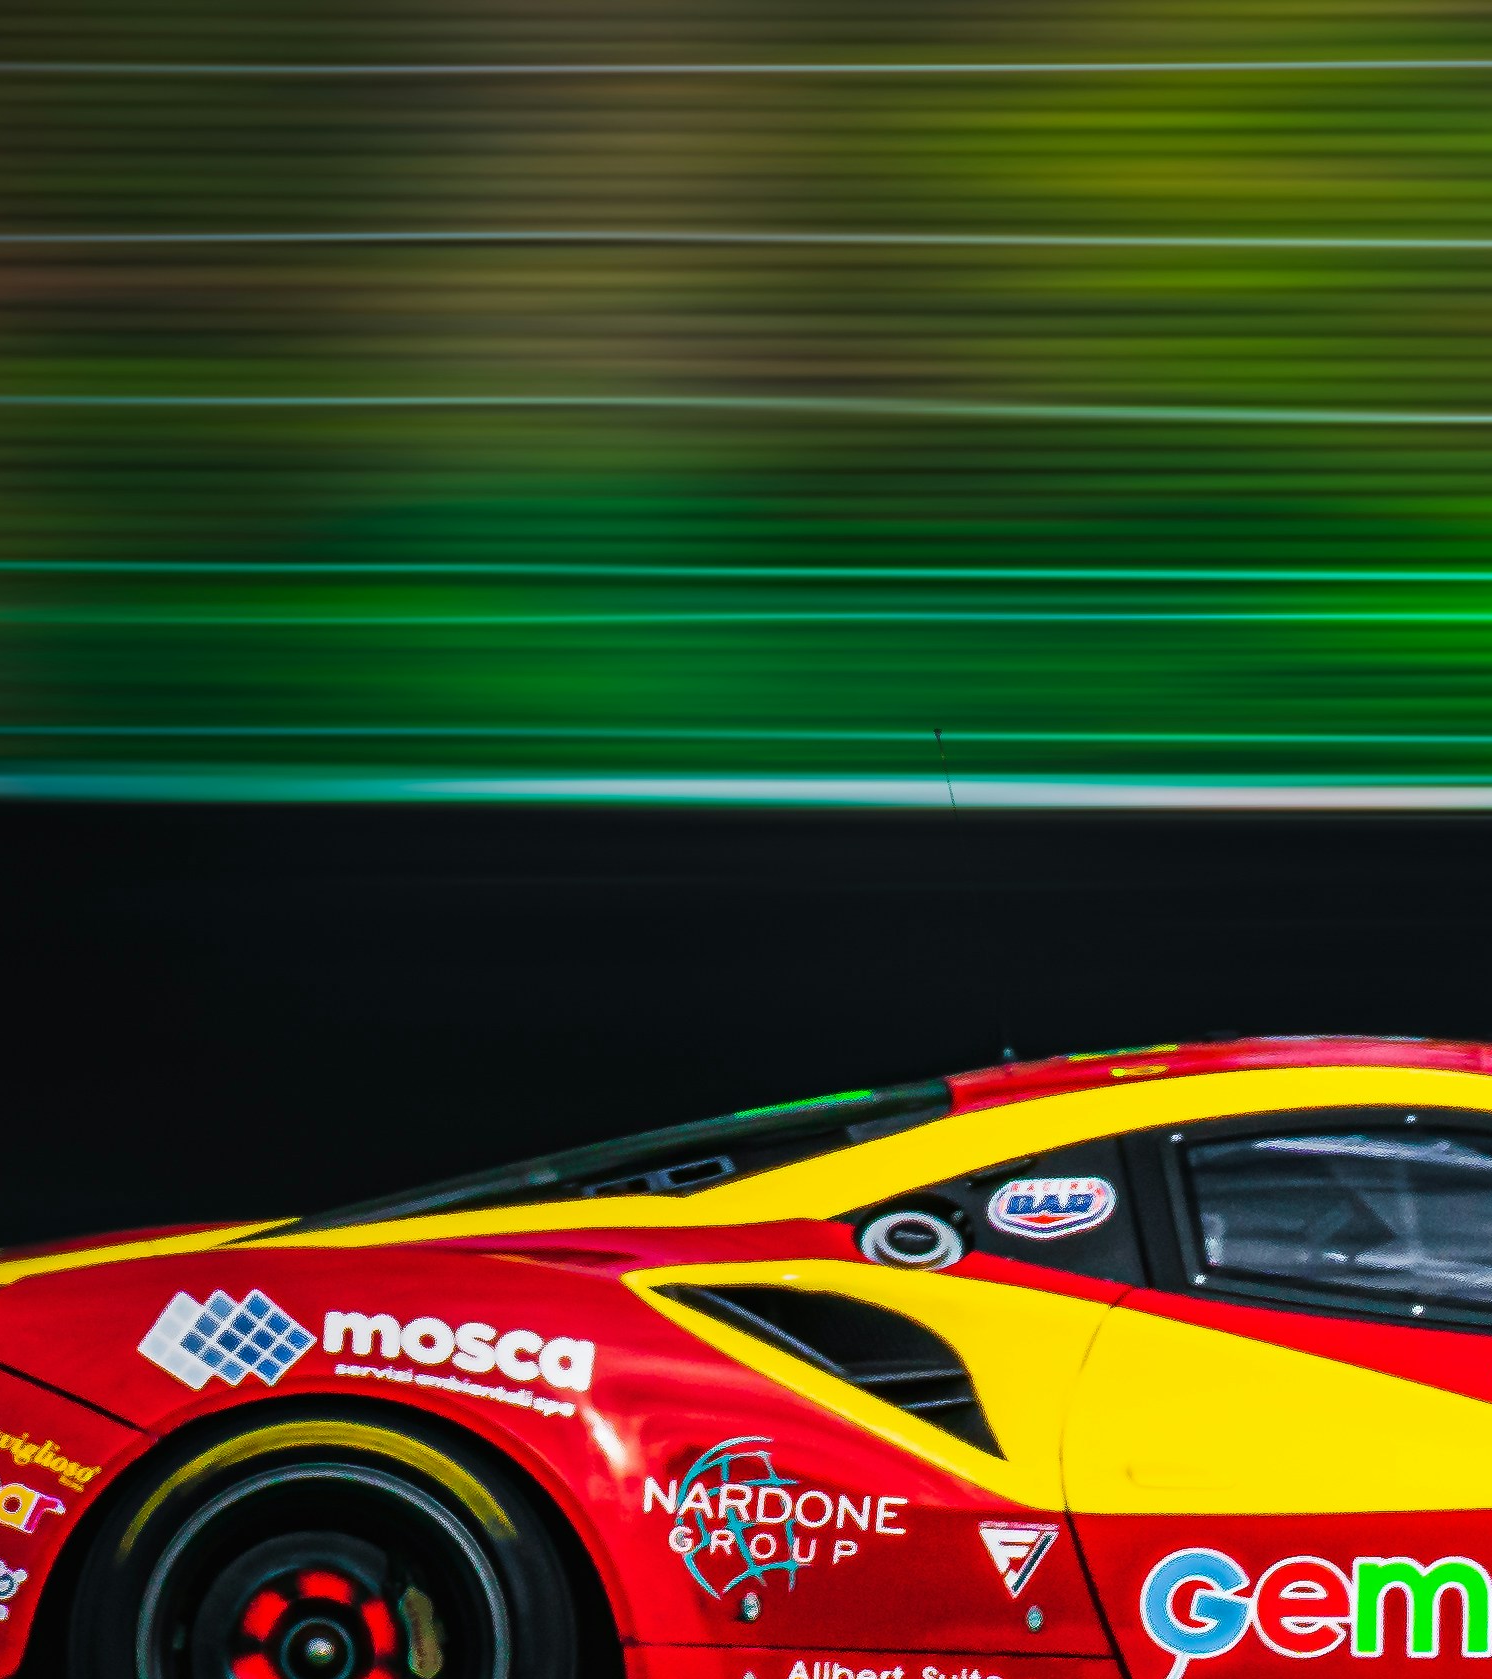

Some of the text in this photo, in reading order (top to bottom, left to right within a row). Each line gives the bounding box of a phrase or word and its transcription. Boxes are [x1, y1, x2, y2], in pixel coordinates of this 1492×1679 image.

[322, 1310, 596, 1391] mosca
[642, 1476, 908, 1535] NARDONE
[668, 1525, 858, 1564] GROUP
